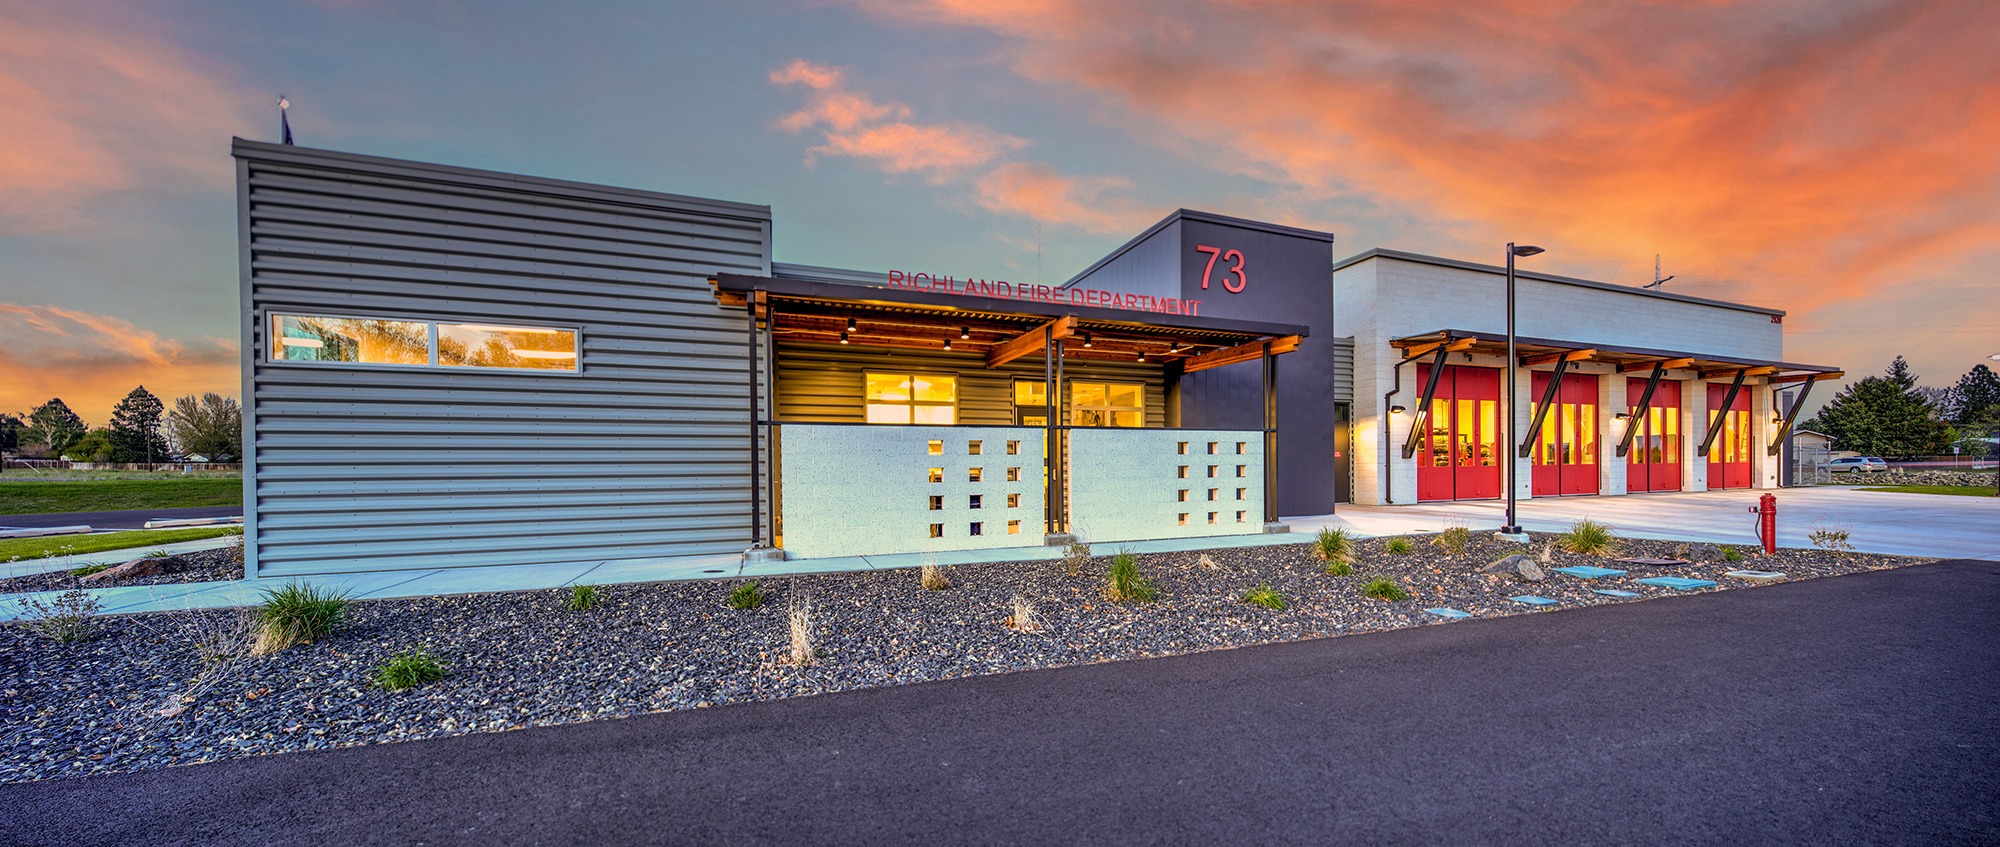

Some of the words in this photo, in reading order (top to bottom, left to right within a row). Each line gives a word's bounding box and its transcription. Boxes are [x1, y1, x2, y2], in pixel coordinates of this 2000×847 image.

[1196, 244, 1247, 294] 73
[888, 270, 1012, 298] RICHLAND
[1017, 282, 1066, 304] FIRE
[1071, 287, 1202, 317] DEPARTMENT
